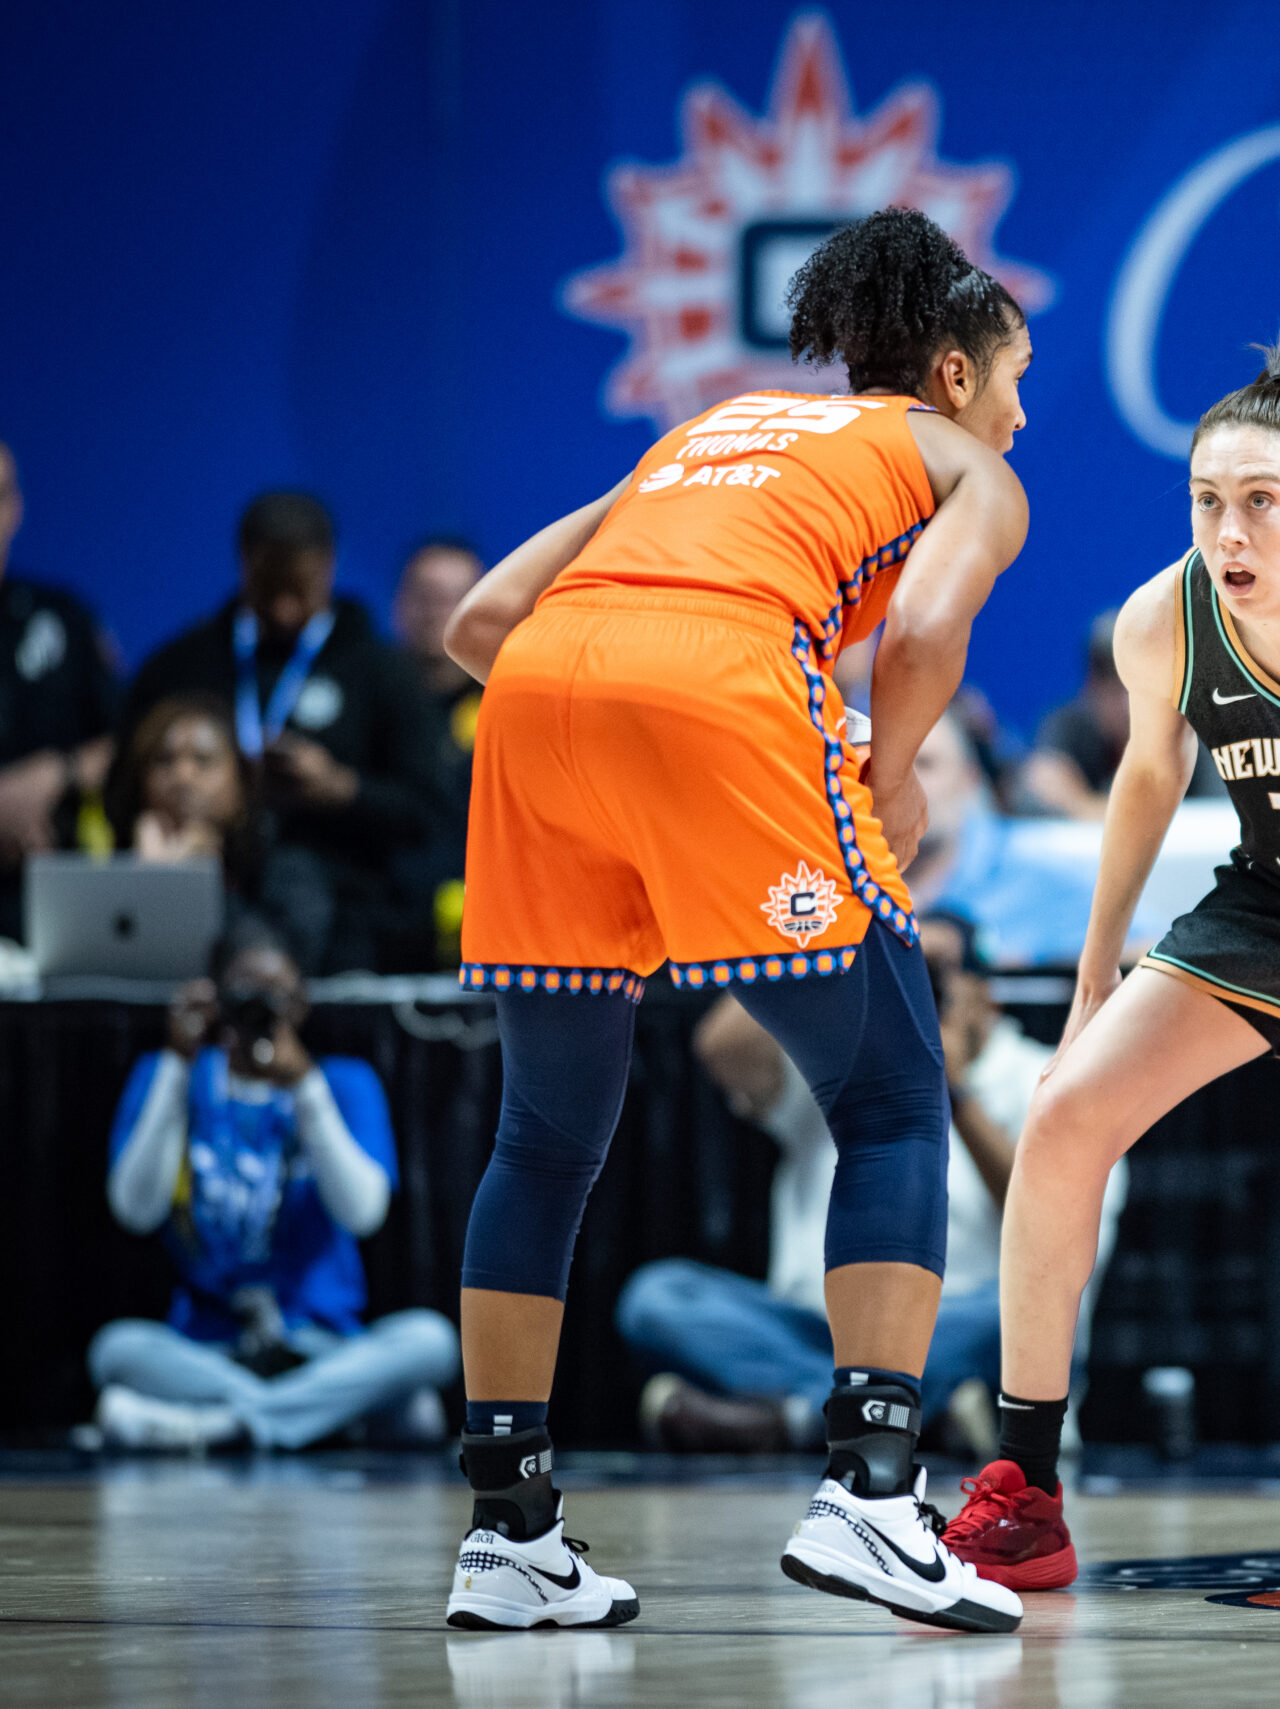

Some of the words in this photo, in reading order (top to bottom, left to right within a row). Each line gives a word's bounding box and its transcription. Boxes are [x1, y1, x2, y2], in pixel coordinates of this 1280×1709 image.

[686, 396, 888, 434] 25
[676, 432, 799, 460] THOMAS
[683, 464, 781, 488] AT&T
